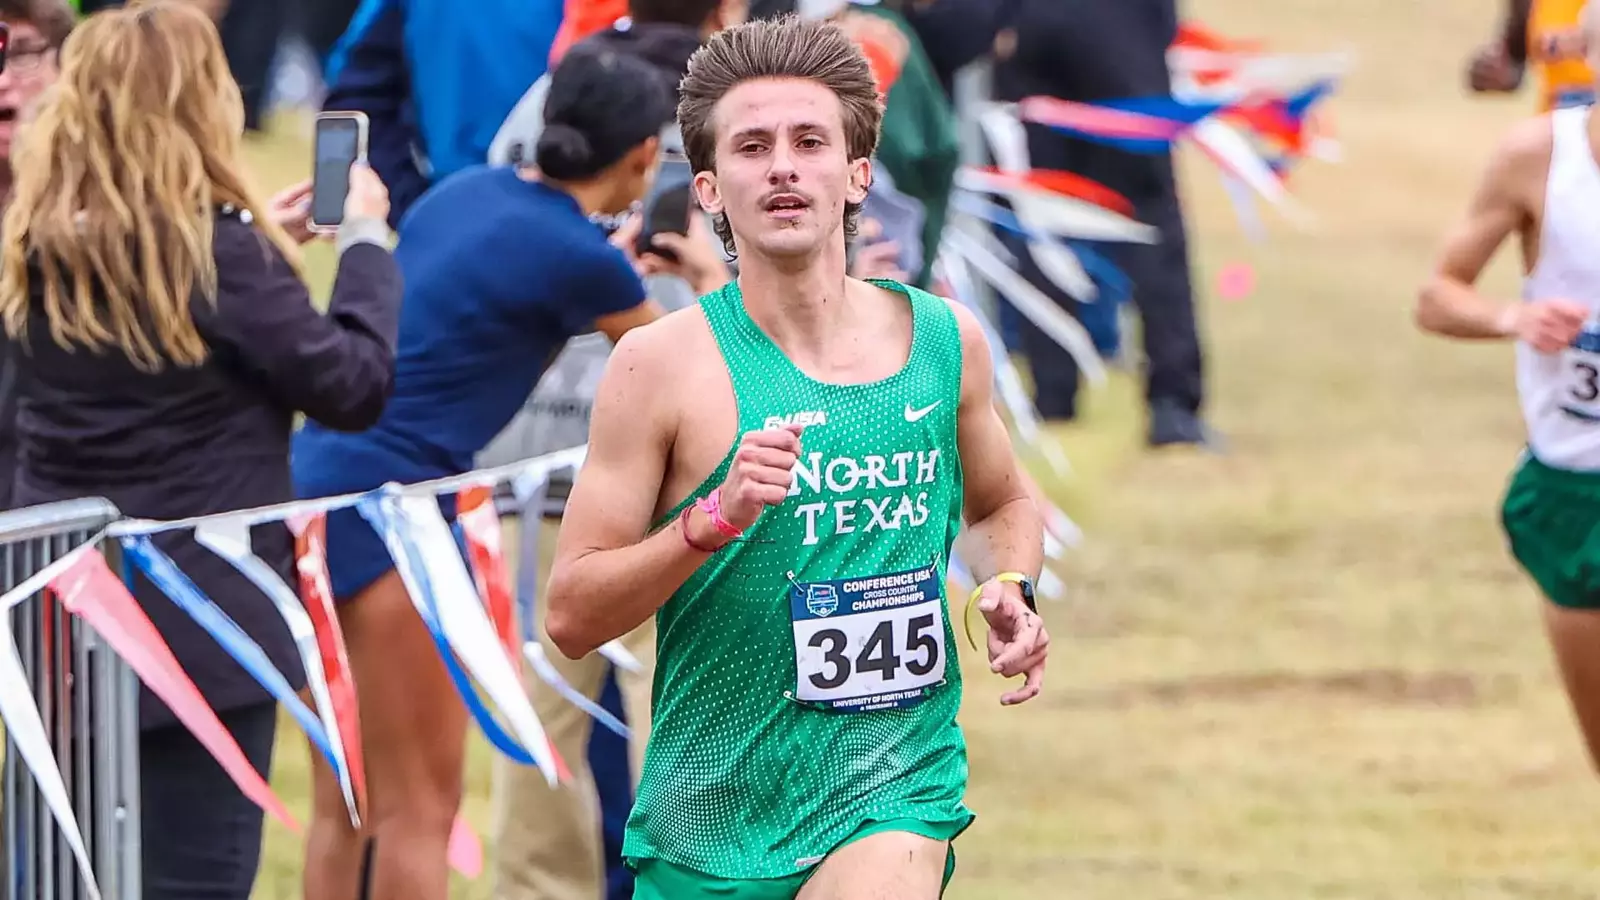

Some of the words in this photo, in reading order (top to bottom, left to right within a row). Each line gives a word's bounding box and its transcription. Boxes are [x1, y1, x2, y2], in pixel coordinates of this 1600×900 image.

[788, 450, 941, 496] NORTH
[794, 491, 930, 546] TEXAS
[843, 573, 914, 593] CONFERENCE
[914, 569, 931, 581] USA
[863, 589, 887, 600] CROSS
[887, 584, 918, 596] COUNTRY
[852, 591, 925, 611] CHAMPIONSHIPS
[807, 612, 939, 690] 345
[833, 697, 872, 708] UNIVERSITY
[872, 695, 882, 704] OF
[882, 692, 904, 702] NORTH
